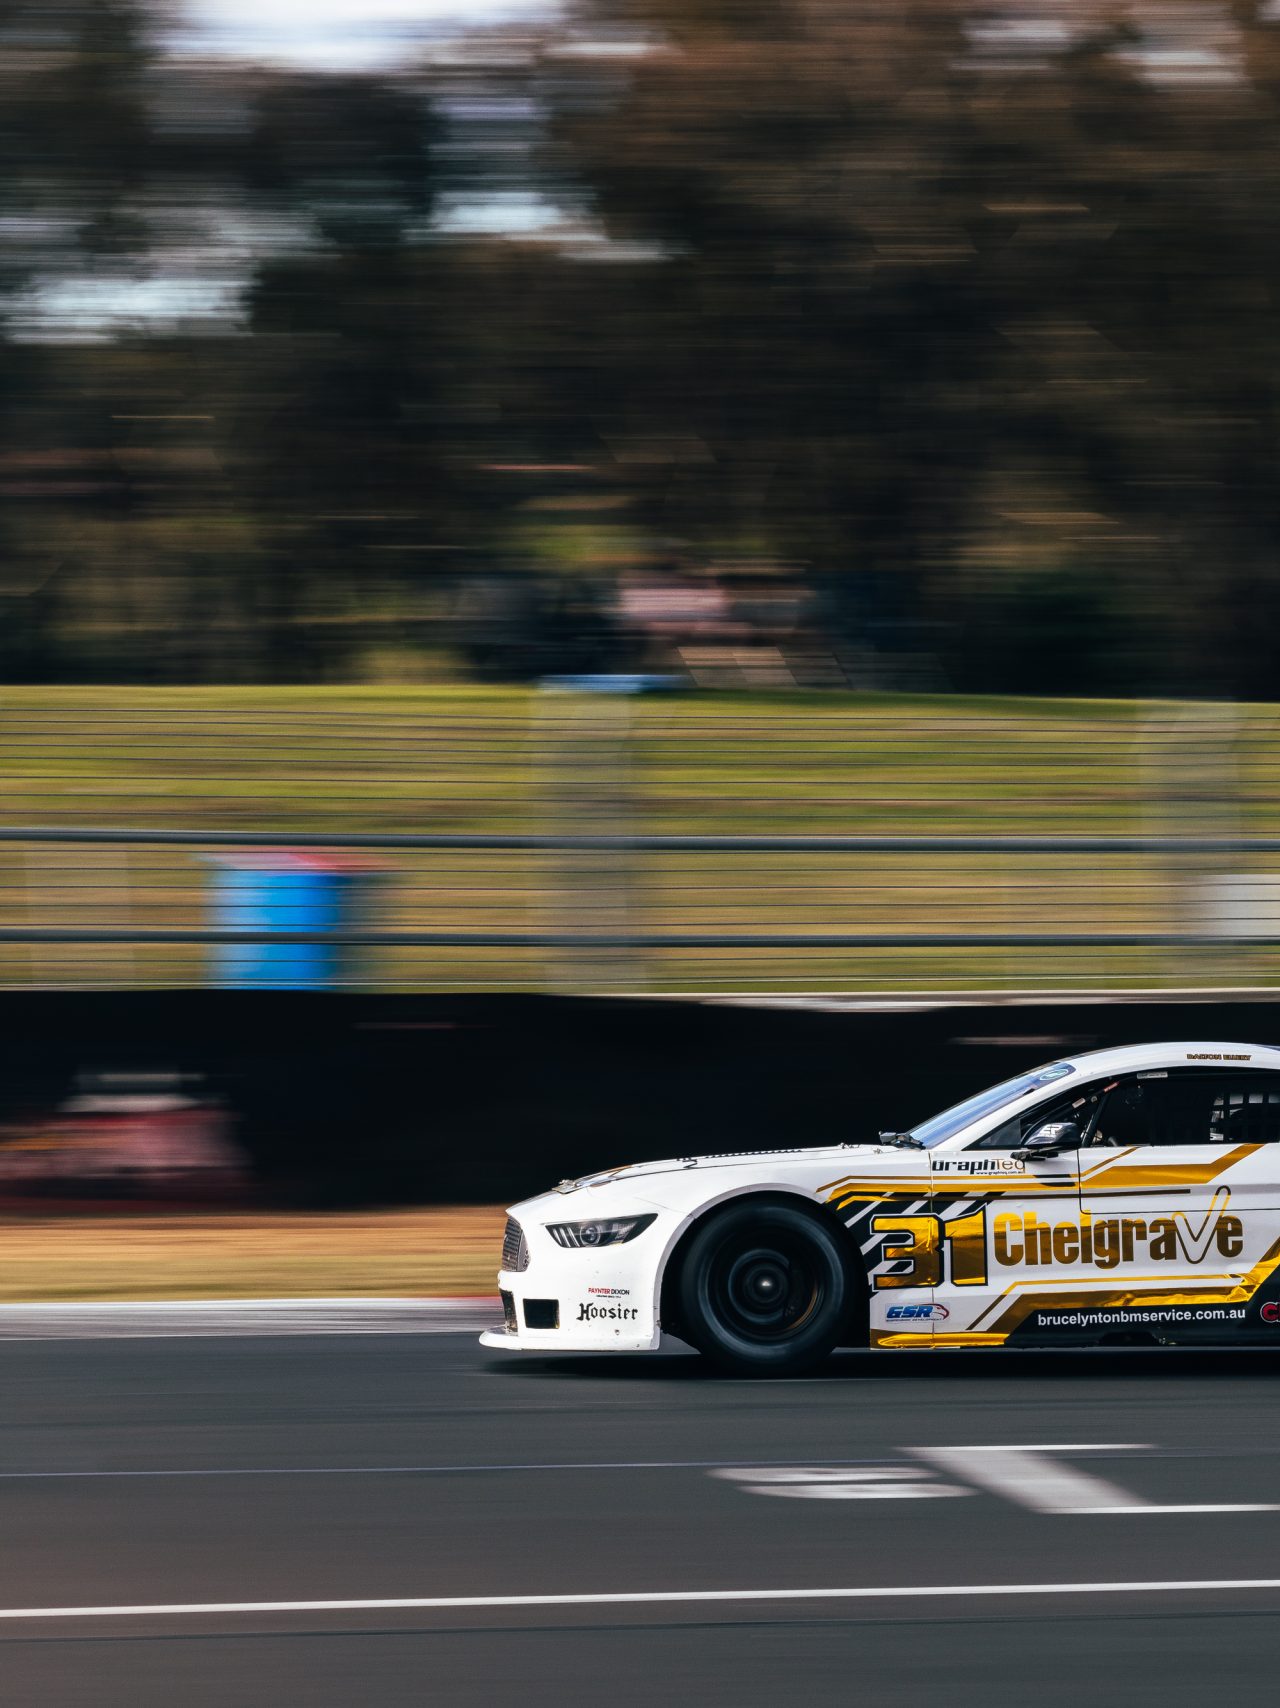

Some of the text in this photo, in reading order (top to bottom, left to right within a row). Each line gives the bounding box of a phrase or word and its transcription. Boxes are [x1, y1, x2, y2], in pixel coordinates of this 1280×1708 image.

[870, 1203, 989, 1290] 31
[611, 1288, 630, 1296] DIXON
[576, 1302, 639, 1321] Hoosier
[886, 1305, 934, 1319] GSR
[1037, 1308, 1246, 1327] brucelyntonbmservice.com.au
